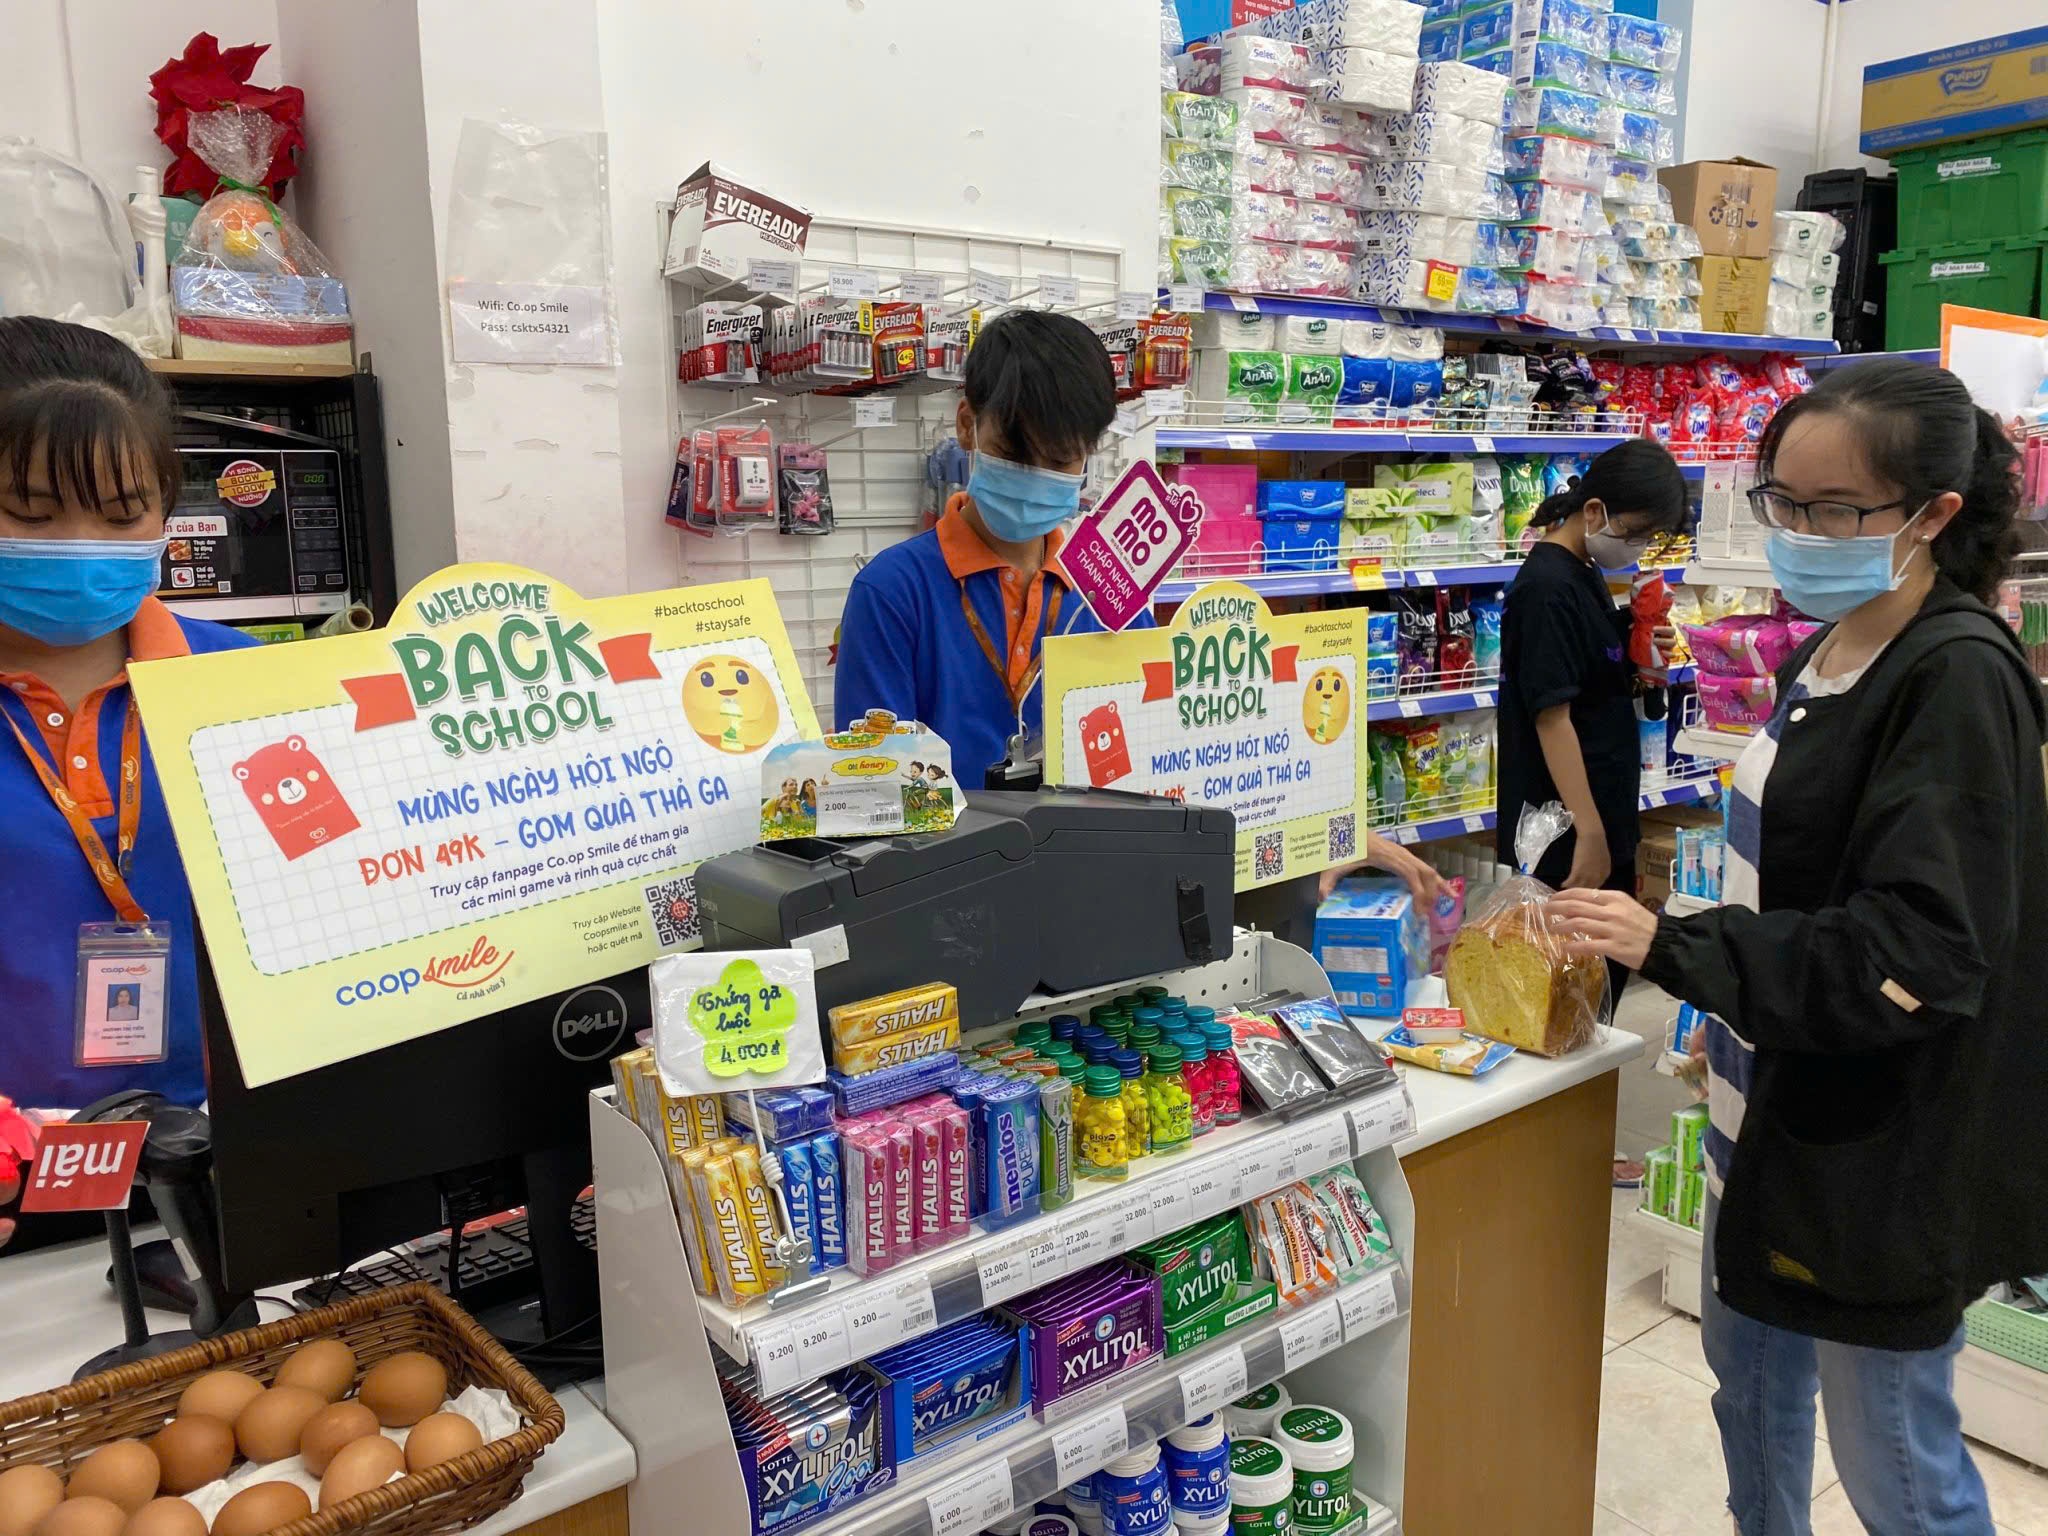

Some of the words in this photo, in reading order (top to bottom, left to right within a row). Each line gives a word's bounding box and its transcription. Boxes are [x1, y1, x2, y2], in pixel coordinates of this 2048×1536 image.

[1945, 67, 1988, 84] Pulppy
[676, 187, 708, 208] EVEREADY
[713, 190, 804, 244] EVEREADY
[832, 278, 853, 286] 58.900
[478, 300, 504, 310] Wifi:
[507, 301, 537, 314] Co.op
[540, 302, 569, 313] Smile
[706, 313, 762, 335] Energizer
[815, 310, 859, 326] Energizer
[874, 312, 918, 329] EVEREADY
[930, 320, 970, 334] Energizer
[480, 322, 508, 332] Pass:
[511, 322, 570, 334] csktx54321
[1149, 326, 1187, 337] EVEREADY
[1242, 369, 1275, 383] AnAn
[1302, 372, 1331, 386] AnAn
[1692, 420, 1710, 435] OMO
[231, 474, 260, 486] 800W
[304, 474, 325, 484] 0:00
[232, 484, 265, 496] 1000W
[198, 521, 217, 535] Bạn
[1090, 540, 1113, 569] CHẤP
[1109, 567, 1133, 600] NHẬN
[1076, 548, 1104, 588] THANH
[1101, 584, 1126, 615] TOÁN
[416, 581, 549, 627] WELCOME
[654, 595, 745, 618] #backtoschool
[1190, 596, 1257, 629] WELCOME
[696, 616, 751, 633] #staysafe
[1304, 619, 1353, 635] #backtoschool
[1322, 636, 1353, 649] #staysafe
[391, 615, 608, 707] BACK
[1172, 623, 1272, 691] BACK
[523, 684, 550, 701] TO
[1227, 678, 1241, 692] TO
[1178, 686, 1268, 731] SCHOOL
[430, 690, 616, 758] SCHOOL
[1151, 748, 1191, 776] MỪNG
[1196, 740, 1232, 768] NGÀY
[1236, 734, 1260, 762] HỘI
[1264, 728, 1290, 755] NGỘ
[398, 783, 481, 827] MỪNG
[486, 765, 560, 810] NGÀY
[566, 751, 617, 790] HỘI
[622, 738, 674, 779] NGỘ
[1204, 775, 1233, 801] GOM
[1237, 766, 1262, 793] QUÀ
[1267, 757, 1291, 787] THẢ
[1295, 759, 1311, 782] GA
[825, 802, 847, 812] 2.000
[1233, 801, 1251, 813] Smile
[1260, 796, 1275, 807] tham
[358, 844, 426, 887] ĐƠN
[435, 832, 486, 867] 49K
[518, 810, 576, 849] GOM
[584, 791, 636, 832] QUÀ
[640, 776, 695, 819] THẢ
[698, 775, 730, 806] GA
[430, 881, 462, 900] Truy
[465, 874, 490, 893] cập
[491, 860, 545, 887] fanpage
[546, 849, 586, 874] Co.op
[587, 840, 621, 859] Smile
[622, 832, 639, 852] để
[639, 829, 670, 847] tham
[670, 823, 691, 845] gia
[461, 895, 486, 912] các
[487, 888, 517, 905] mini
[518, 879, 555, 903] game
[556, 869, 574, 888] và
[575, 864, 600, 883] rinh
[602, 856, 626, 878] quà
[626, 850, 651, 873] cực
[652, 841, 678, 866] chất
[572, 918, 592, 931] Truy
[609, 904, 642, 919] Website
[583, 919, 639, 942] Coopsmile.vn
[609, 935, 629, 950] quét
[336, 967, 421, 1007] co.op
[422, 934, 507, 986] smile
[562, 1009, 620, 1038] DELL
[875, 997, 946, 1035] HALLS
[720, 1042, 768, 1064] 4.000
[878, 1028, 948, 1066] HALLS
[1357, 1119, 1375, 1132] 25.000
[1293, 1143, 1313, 1156] 25.000
[35, 1140, 128, 1190] mãi
[998, 1112, 1024, 1216] mentos
[921, 1157, 940, 1234] HALLS
[949, 1149, 968, 1224] HALLS
[1191, 1182, 1212, 1195] 32.000
[895, 1168, 913, 1245] HALLS
[1153, 1195, 1175, 1209] 32.000
[816, 1175, 843, 1255] HALLS
[868, 1181, 889, 1259] HALLS
[1125, 1208, 1147, 1222] 32.000
[745, 1186, 786, 1270] HALLS
[1336, 1215, 1348, 1235] MINT
[716, 1197, 758, 1284] HALLS
[1065, 1230, 1089, 1246] 27.200
[1350, 1227, 1366, 1260] FRIEND
[1030, 1242, 1055, 1258] 27.200
[983, 1261, 1009, 1279] 32.000
[1177, 1261, 1196, 1275] LOTTE
[1301, 1246, 1312, 1280] FRIEND
[1176, 1257, 1239, 1311] XYLITOL
[1245, 1303, 1258, 1316] LIME
[1258, 1296, 1271, 1309] MINT
[854, 1312, 877, 1328] 9.200
[803, 1331, 829, 1348] 9.200
[1066, 1332, 1091, 1348] LOTTE
[1287, 1336, 1305, 1350] 21.000
[769, 1344, 794, 1361] 9.200
[1062, 1327, 1148, 1385] XYLITOL
[919, 1391, 947, 1407] LOTTE
[1190, 1384, 1207, 1398] 6.000
[913, 1380, 1001, 1432] XYLITOL
[1289, 1415, 1334, 1434] XYLITOL
[1064, 1445, 1083, 1460] 6.000
[1230, 1445, 1275, 1468] XYLITOL
[762, 1454, 794, 1473] LOTTE
[762, 1431, 873, 1502] XYLITOL
[819, 1457, 877, 1503] Cool
[1130, 1499, 1149, 1507] LOTTE
[940, 1507, 961, 1524] 6.000
